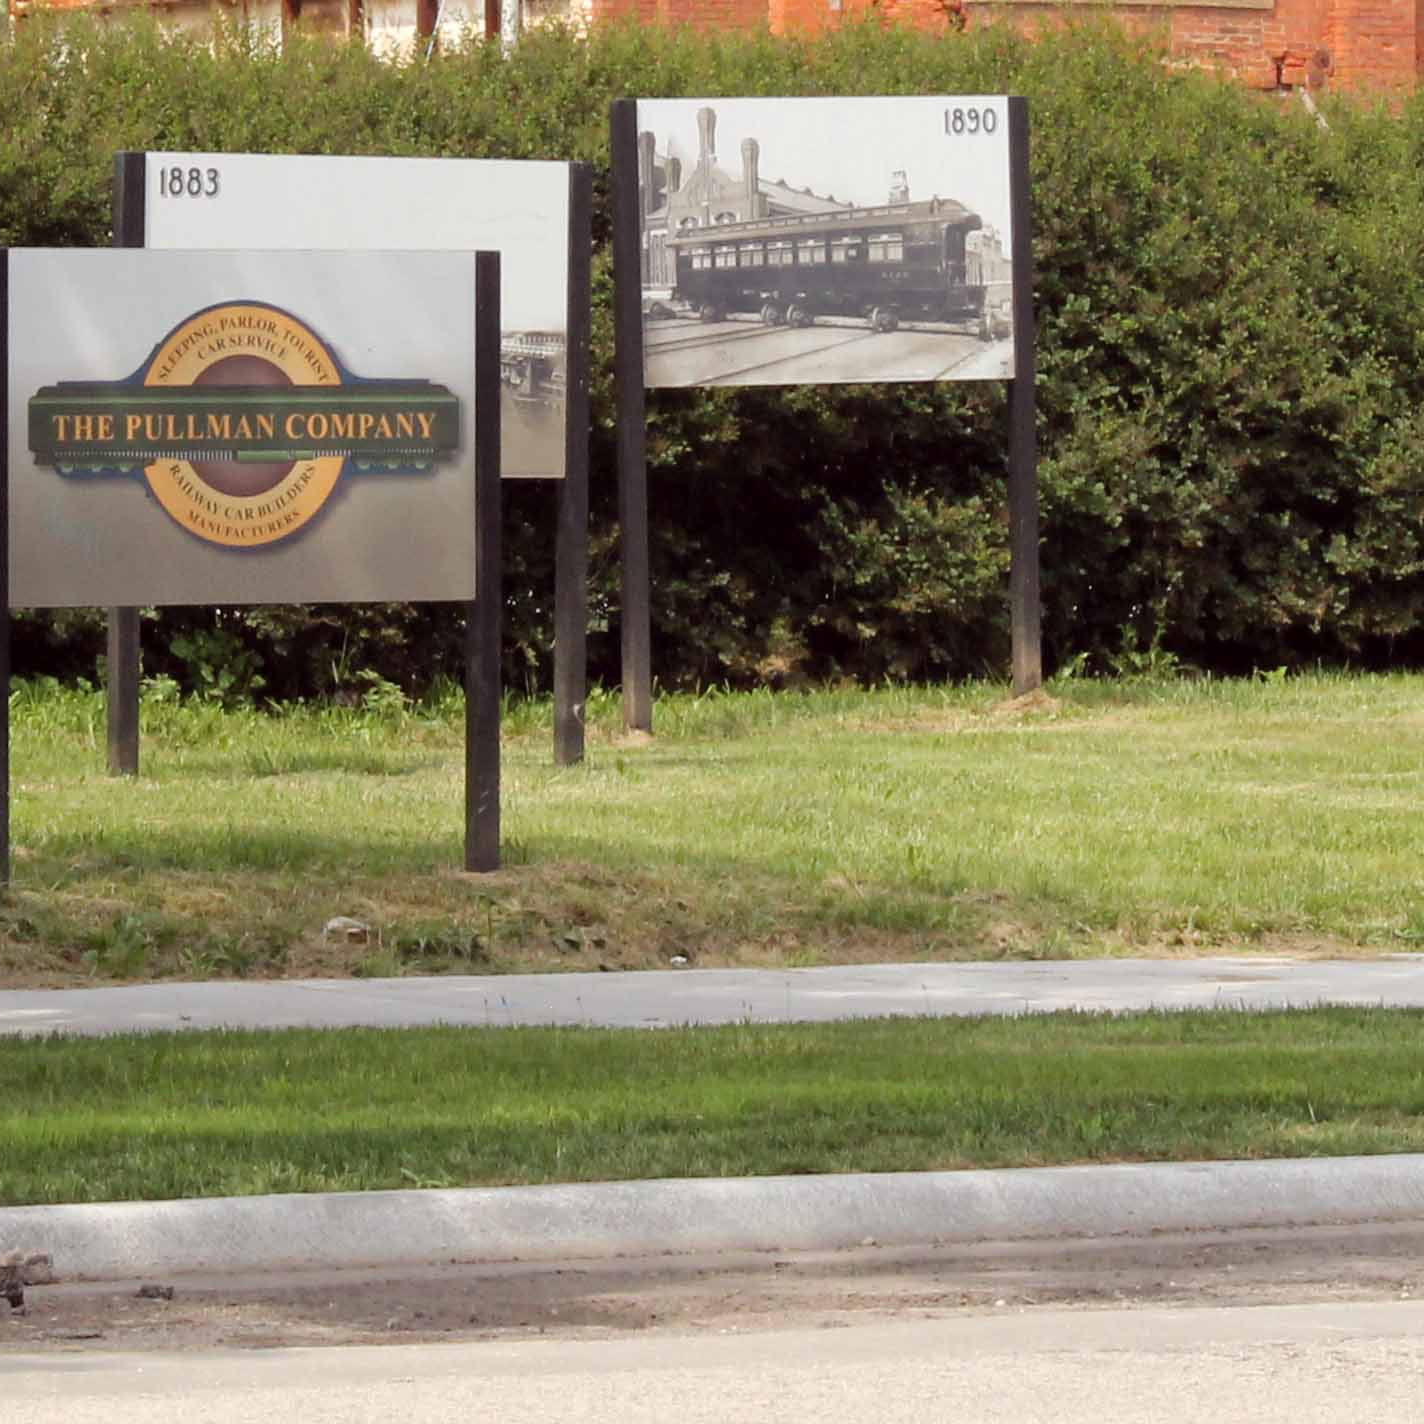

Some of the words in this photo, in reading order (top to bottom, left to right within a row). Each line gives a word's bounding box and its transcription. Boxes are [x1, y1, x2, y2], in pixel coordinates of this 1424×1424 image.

[943, 107, 997, 135] 1890
[159, 167, 220, 197] 1883
[197, 338, 226, 360] CAR
[228, 335, 289, 360] SERVICE
[284, 330, 329, 382] TOURIST
[52, 414, 114, 441] THE
[125, 413, 275, 441] PULLMAN
[285, 412, 436, 440] COMPANY
[169, 464, 221, 515] RAILWAY
[224, 507, 255, 521] CAR
[257, 465, 316, 518] BUILDERS
[187, 509, 302, 538] MANUFACTURERS
